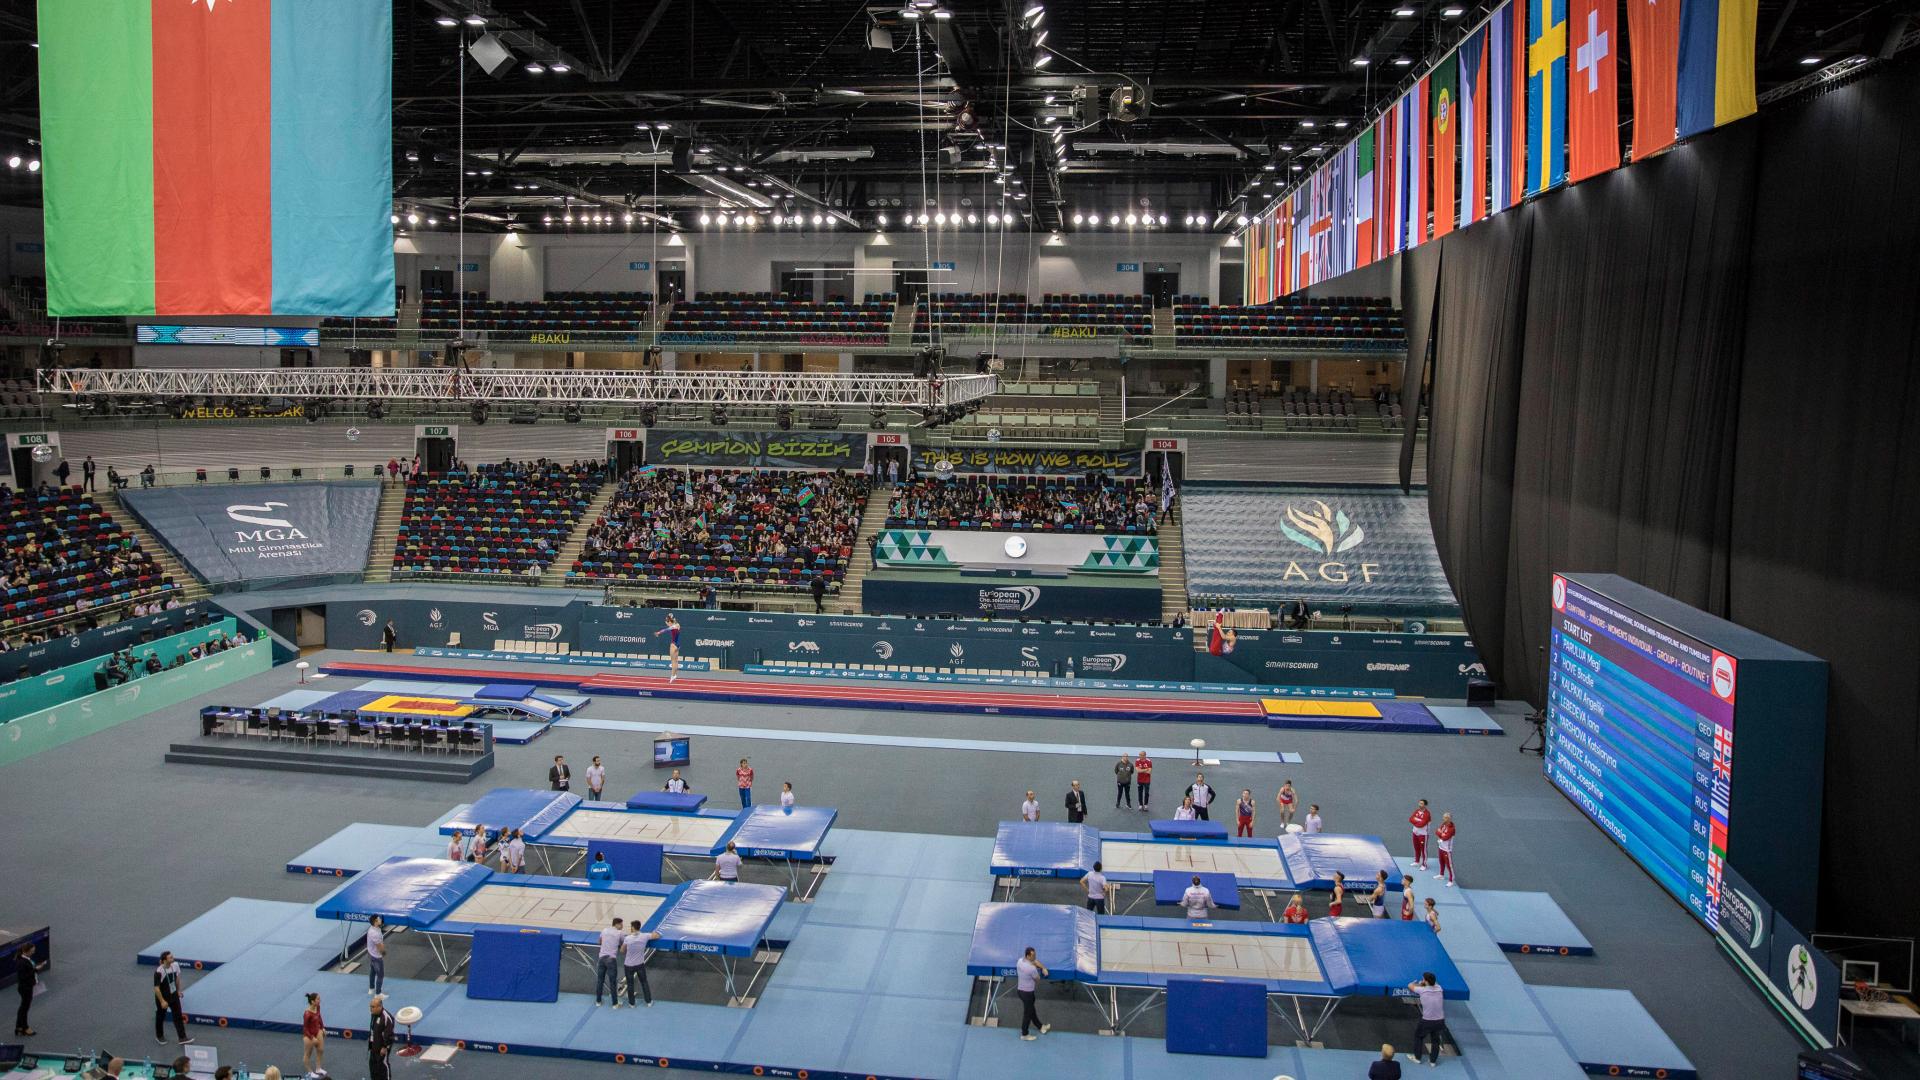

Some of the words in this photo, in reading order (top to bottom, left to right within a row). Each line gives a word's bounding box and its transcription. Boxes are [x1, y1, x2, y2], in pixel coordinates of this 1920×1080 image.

[1121, 263, 1134, 271] 304
[530, 333, 570, 345] #BAKU
[1053, 326, 1097, 339] #BAKU
[430, 427, 443, 435] 107
[619, 430, 632, 438] 106
[25, 435, 42, 443] 108
[882, 435, 896, 443] 105
[1157, 440, 1172, 449] 104
[970, 452, 989, 466] IS
[994, 452, 1036, 466] HOW
[1076, 453, 1129, 468] ROLL
[235, 528, 309, 543] MGA
[258, 542, 324, 552] Gimnastika
[1282, 561, 1379, 582] AGF
[599, 634, 646, 644] SMARTSCORING
[1564, 620, 1580, 637] START
[1581, 629, 1592, 645] LIST
[1688, 646, 1709, 663] TUMBLING
[1021, 660, 1041, 668] MGA
[1265, 661, 1319, 670] SMARTSCORING
[1587, 653, 1601, 673] Megi
[1681, 660, 1705, 683] ROUTINE
[1698, 722, 1711, 737] GEO
[1697, 747, 1710, 762] GBR
[1557, 751, 1577, 777] SPRING
[1577, 769, 1604, 801] Josephine
[1696, 771, 1709, 788] GRE
[1695, 795, 1708, 813] RUS
[1693, 819, 1707, 838] BLR
[1692, 844, 1706, 862] GEO
[1691, 869, 1704, 887] GBR
[1689, 893, 1703, 912] GRE
[1721, 880, 1752, 921] European
